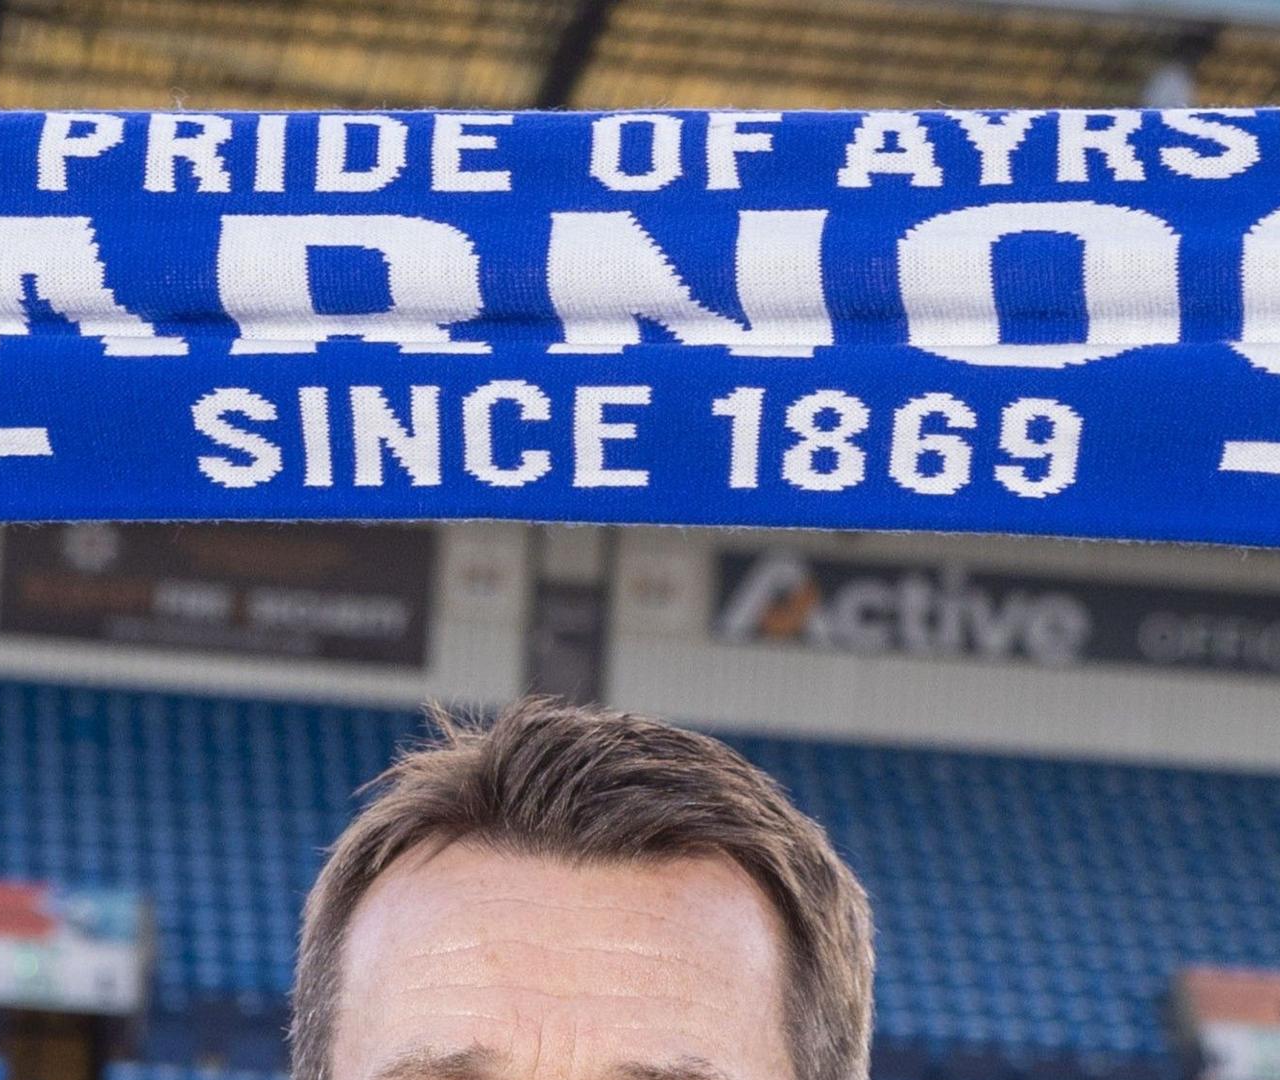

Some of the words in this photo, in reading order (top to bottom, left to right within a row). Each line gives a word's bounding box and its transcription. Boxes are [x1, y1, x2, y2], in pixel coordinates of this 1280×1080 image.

[37, 112, 525, 192] PRIDE
[589, 112, 783, 191] OF
[191, 379, 652, 488] SINCE
[712, 386, 1083, 499] 1869
[714, 548, 1094, 664] Active
